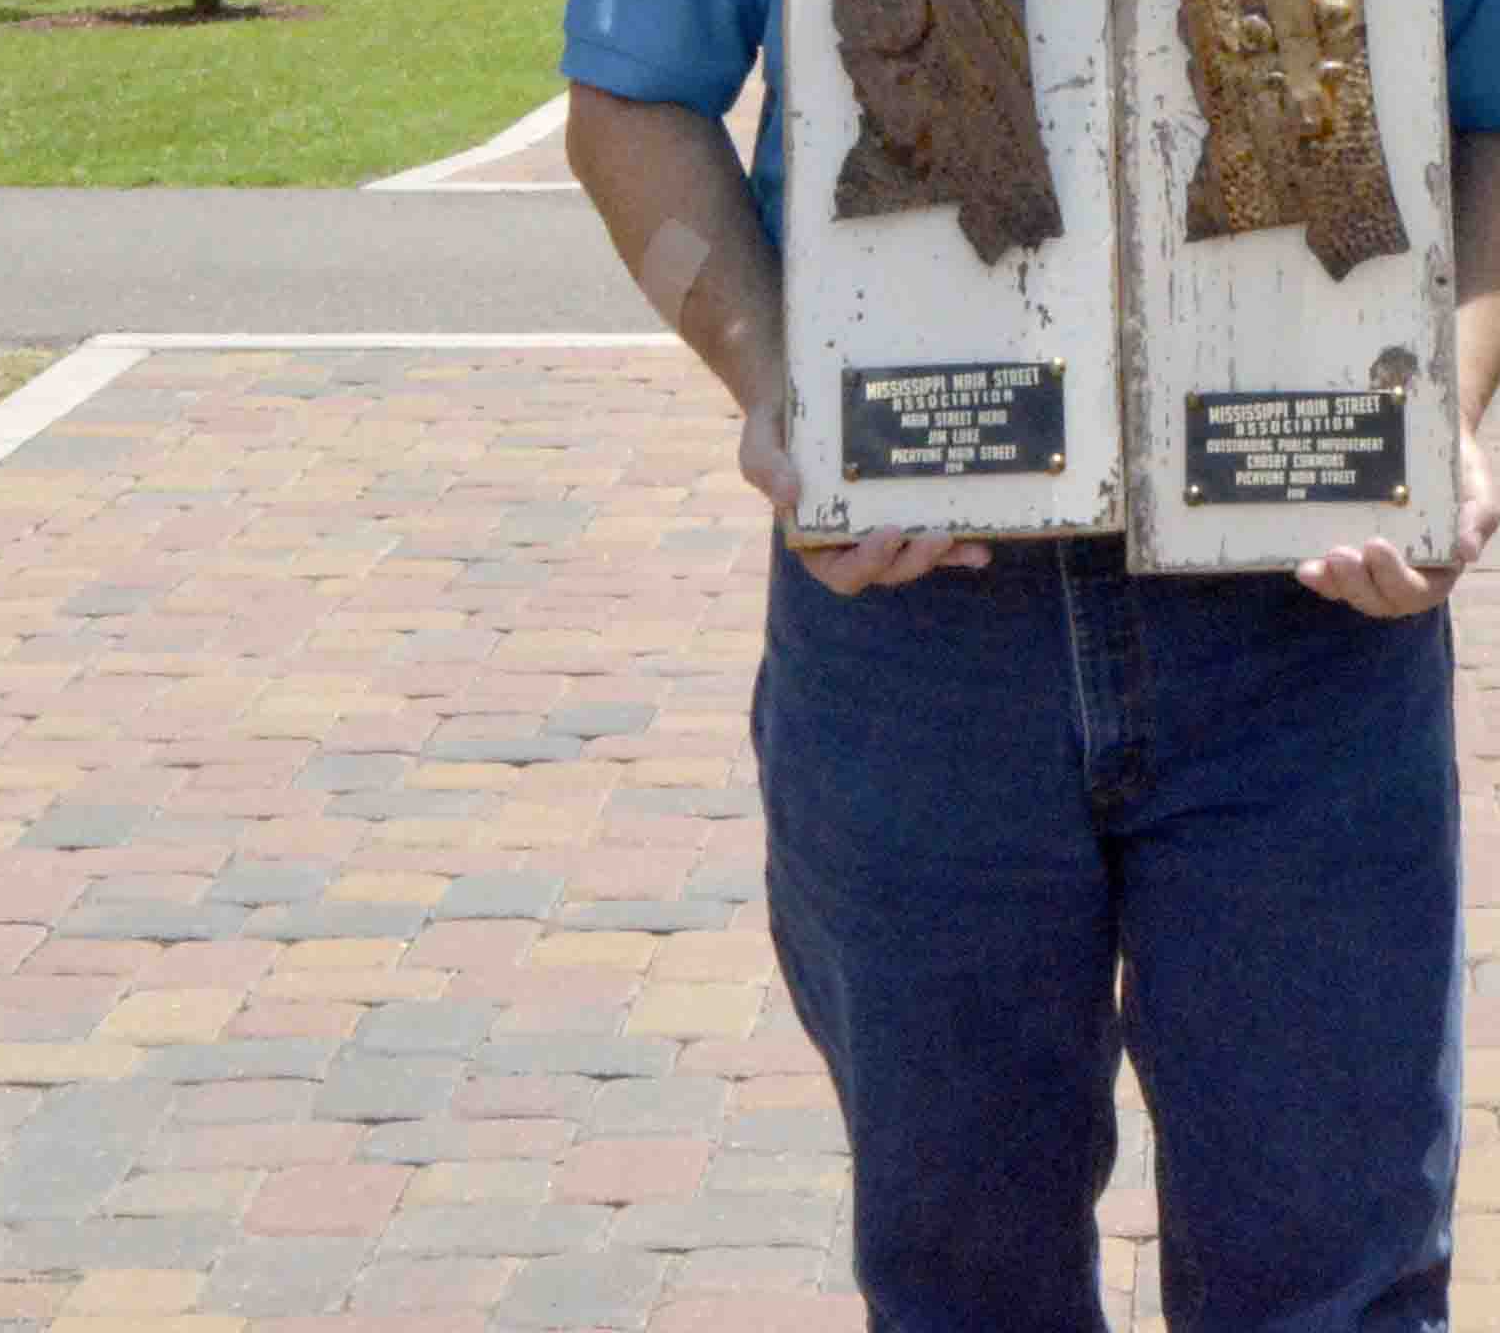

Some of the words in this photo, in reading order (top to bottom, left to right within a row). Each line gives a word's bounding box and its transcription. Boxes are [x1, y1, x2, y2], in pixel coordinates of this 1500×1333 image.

[866, 374, 946, 401] MISSISSIPPI
[953, 371, 988, 389] MAIN
[994, 366, 1041, 387] STREET
[892, 389, 1014, 413] ASSOCIATION
[1208, 401, 1289, 425] MISSISSIPPI
[1295, 399, 1329, 418] MAIN
[1336, 395, 1381, 415] STREET
[901, 413, 930, 428] MAIN
[935, 410, 973, 426] STREET
[1235, 416, 1355, 437] ASSOCIATION
[1277, 438, 1312, 452] PUBLIC
[1316, 436, 1384, 452] IMPROVEMENT
[891, 447, 943, 464] PICAYUNE
[948, 446, 976, 461] MAIN
[980, 445, 1017, 460] STREET
[1246, 453, 1288, 469] CROSBY
[1293, 453, 1346, 469] COMMONS
[1235, 470, 1285, 486] PICAYUNE
[1289, 470, 1317, 485] MAIN
[1321, 469, 1357, 485] STREET
